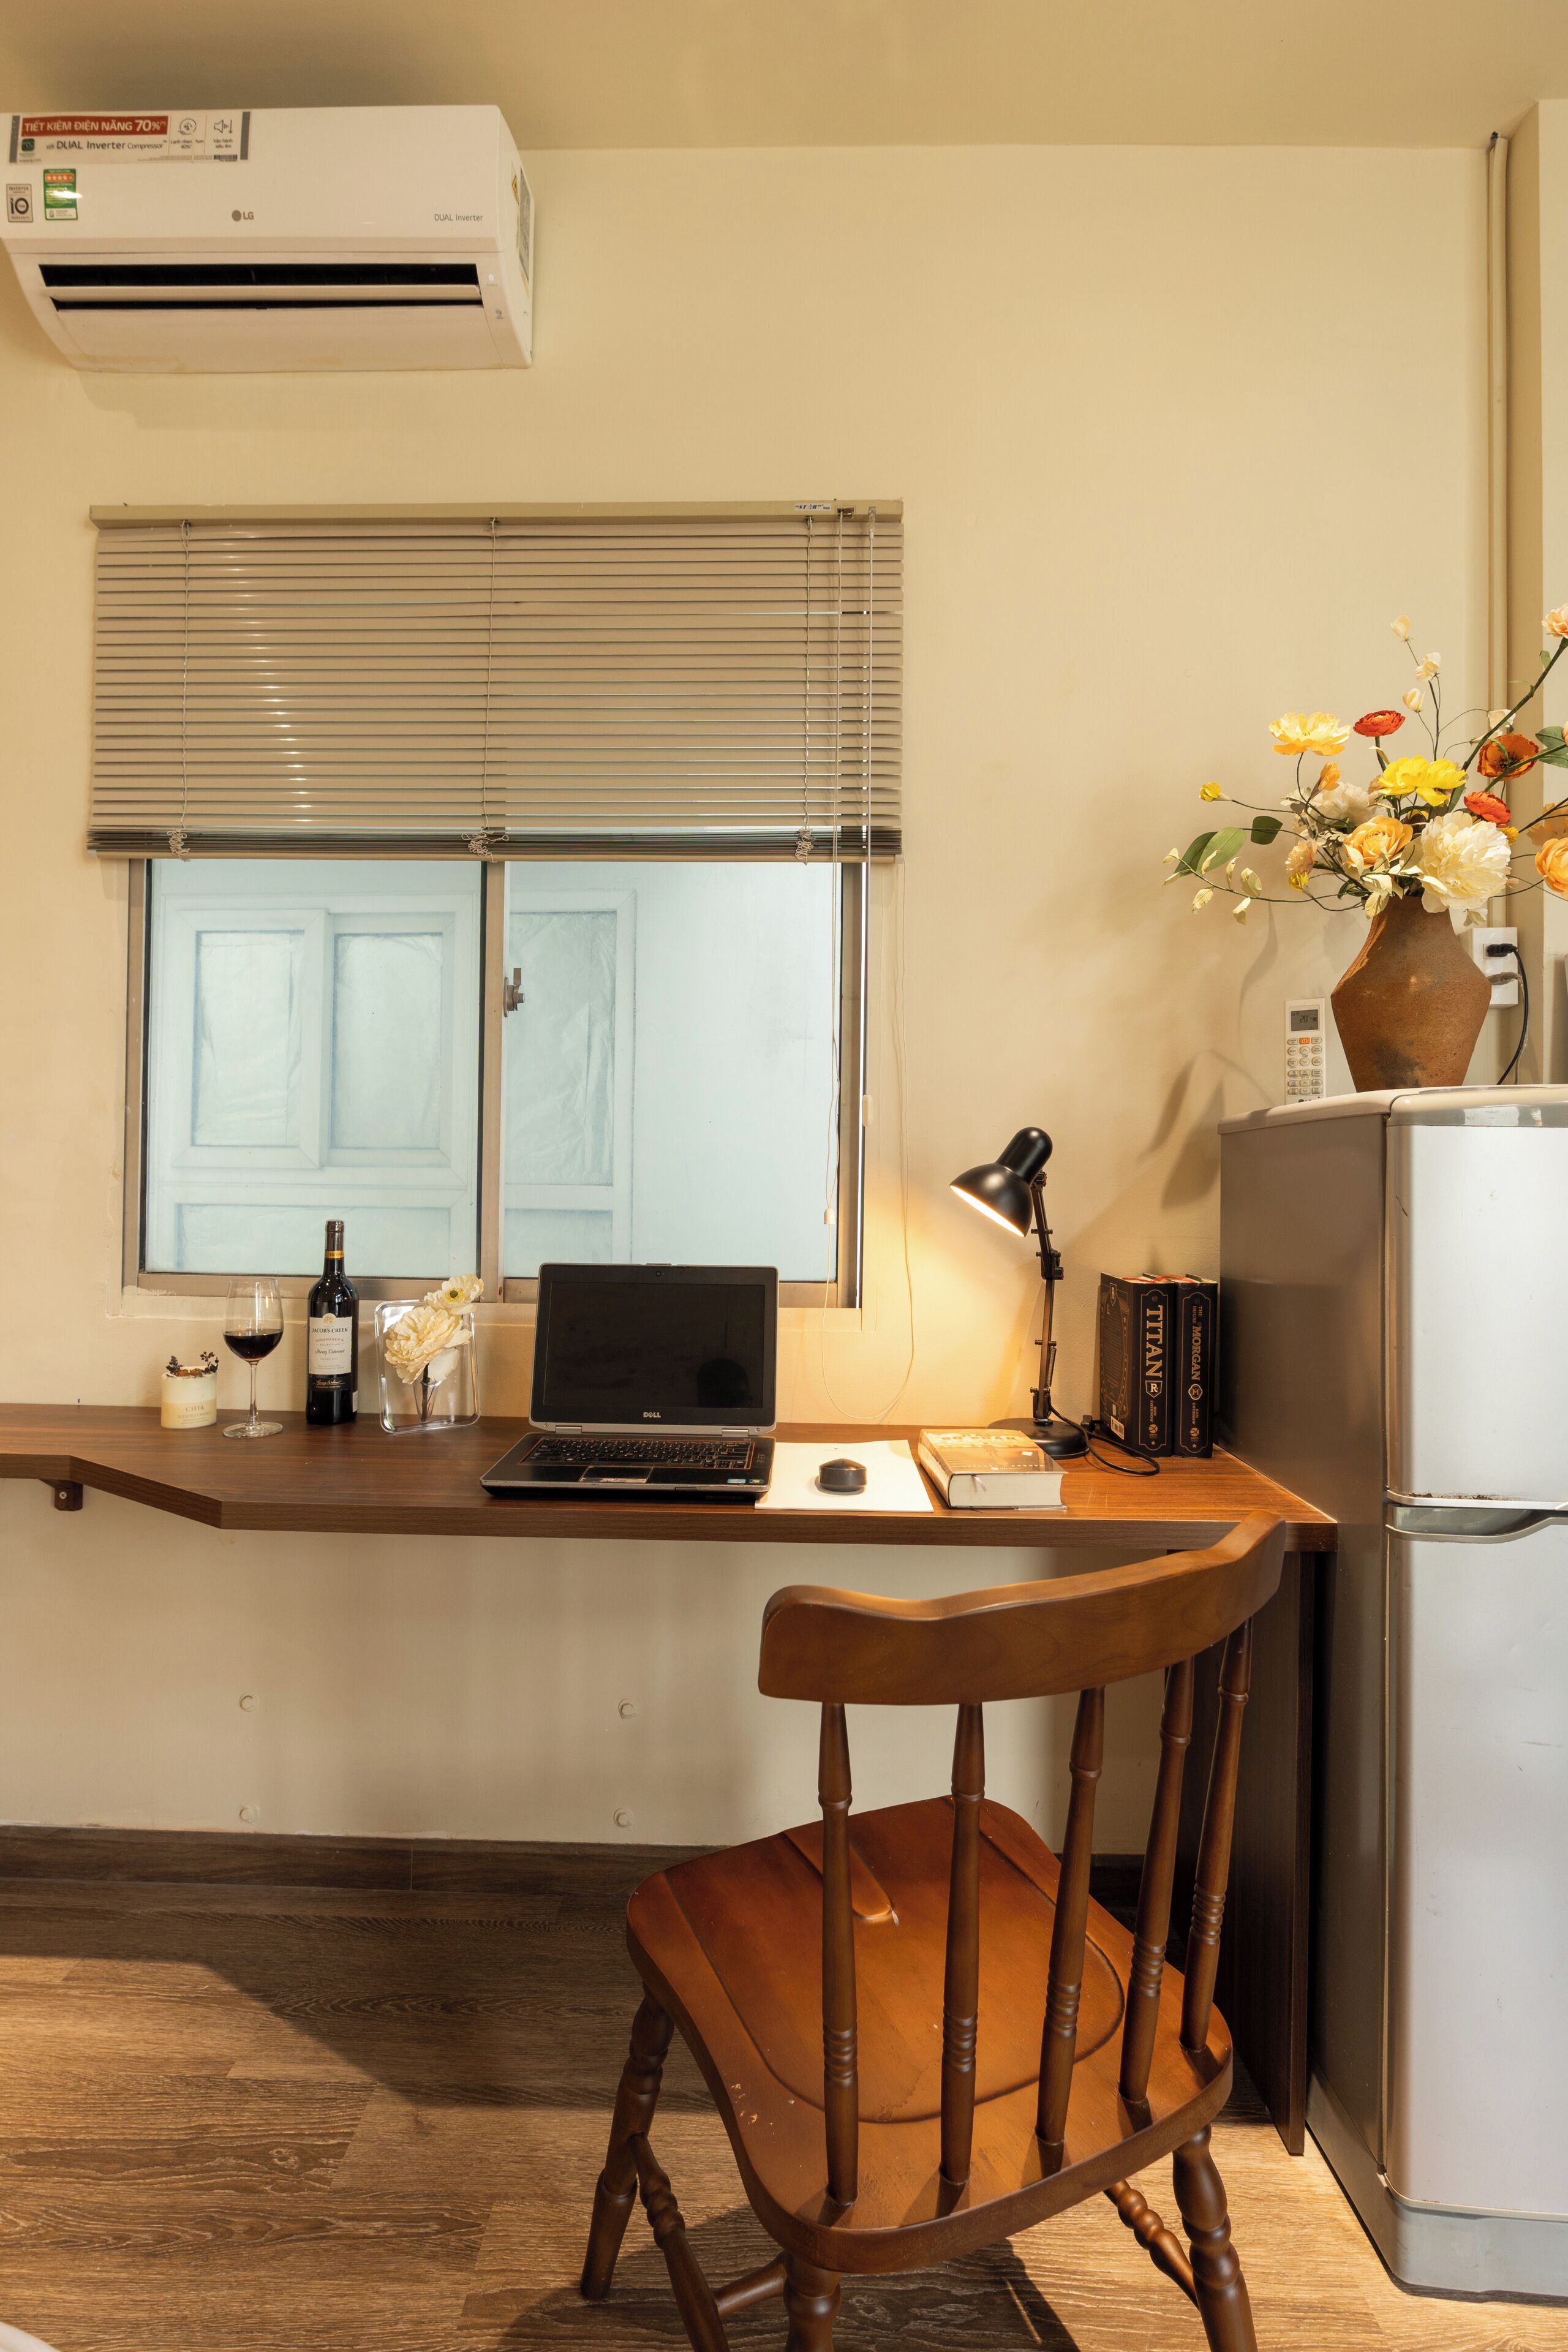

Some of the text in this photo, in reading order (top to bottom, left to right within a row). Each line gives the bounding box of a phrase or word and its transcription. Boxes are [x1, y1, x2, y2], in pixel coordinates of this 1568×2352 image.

[24, 119, 45, 132] TIẾT
[47, 119, 72, 132] KIỆM
[74, 119, 99, 132] ĐIỆN
[101, 119, 132, 130] NĂNG
[56, 140, 83, 149] DUAL
[87, 140, 126, 149] Inverter
[243, 211, 254, 221] LG
[1145, 1305, 1163, 1378] TITAN
[1191, 1325, 1201, 1381] MORGAN
